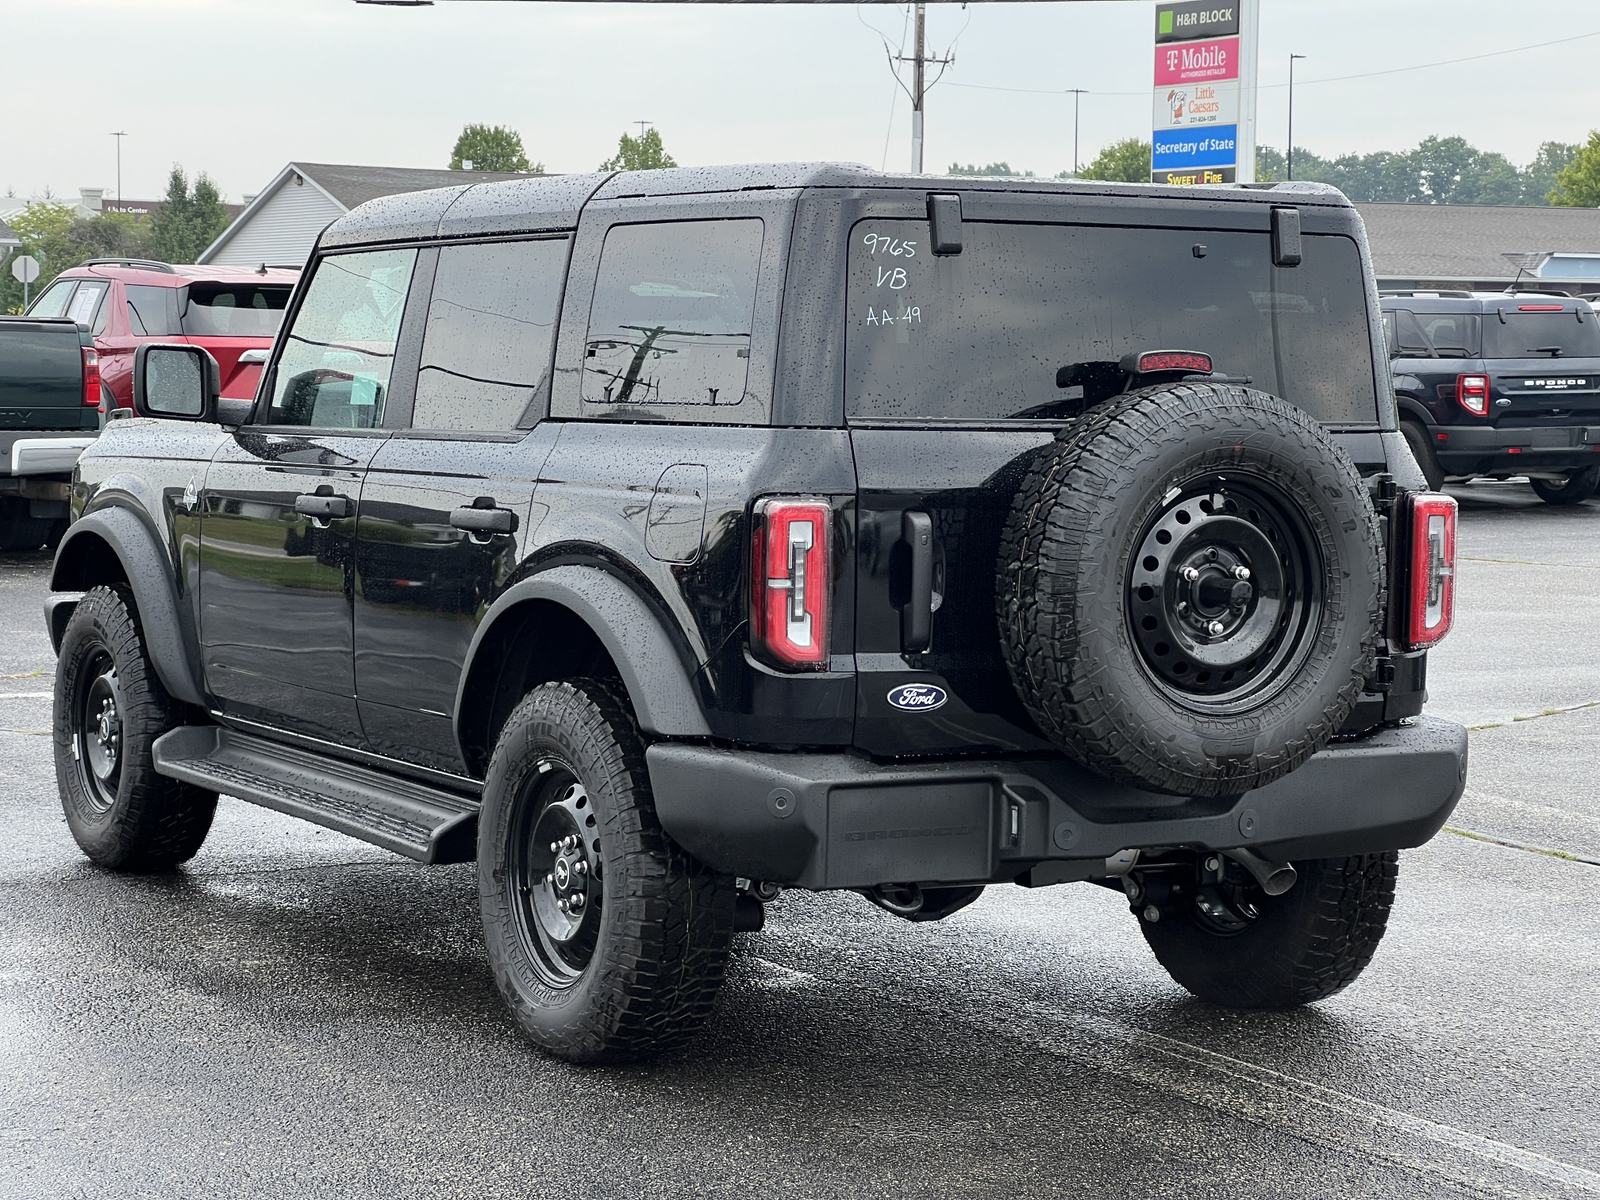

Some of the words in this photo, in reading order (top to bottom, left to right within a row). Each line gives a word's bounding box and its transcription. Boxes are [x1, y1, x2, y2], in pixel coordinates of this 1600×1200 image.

[1176, 12, 1198, 26] H&R
[1200, 8, 1233, 23] BLOCK
[1181, 45, 1227, 70] Mobile
[1181, 70, 1207, 79] AUTHORIZED
[1207, 68, 1226, 76] RETAILER
[1195, 87, 1215, 100] Little
[1188, 100, 1219, 114] Caesars
[1155, 140, 1198, 155] Secretary
[1199, 139, 1209, 151] of
[1210, 138, 1235, 151] State
[127, 206, 148, 214] Center
[863, 233, 918, 258] 9765
[876, 266, 908, 290] VB
[897, 687, 937, 706] Ford
